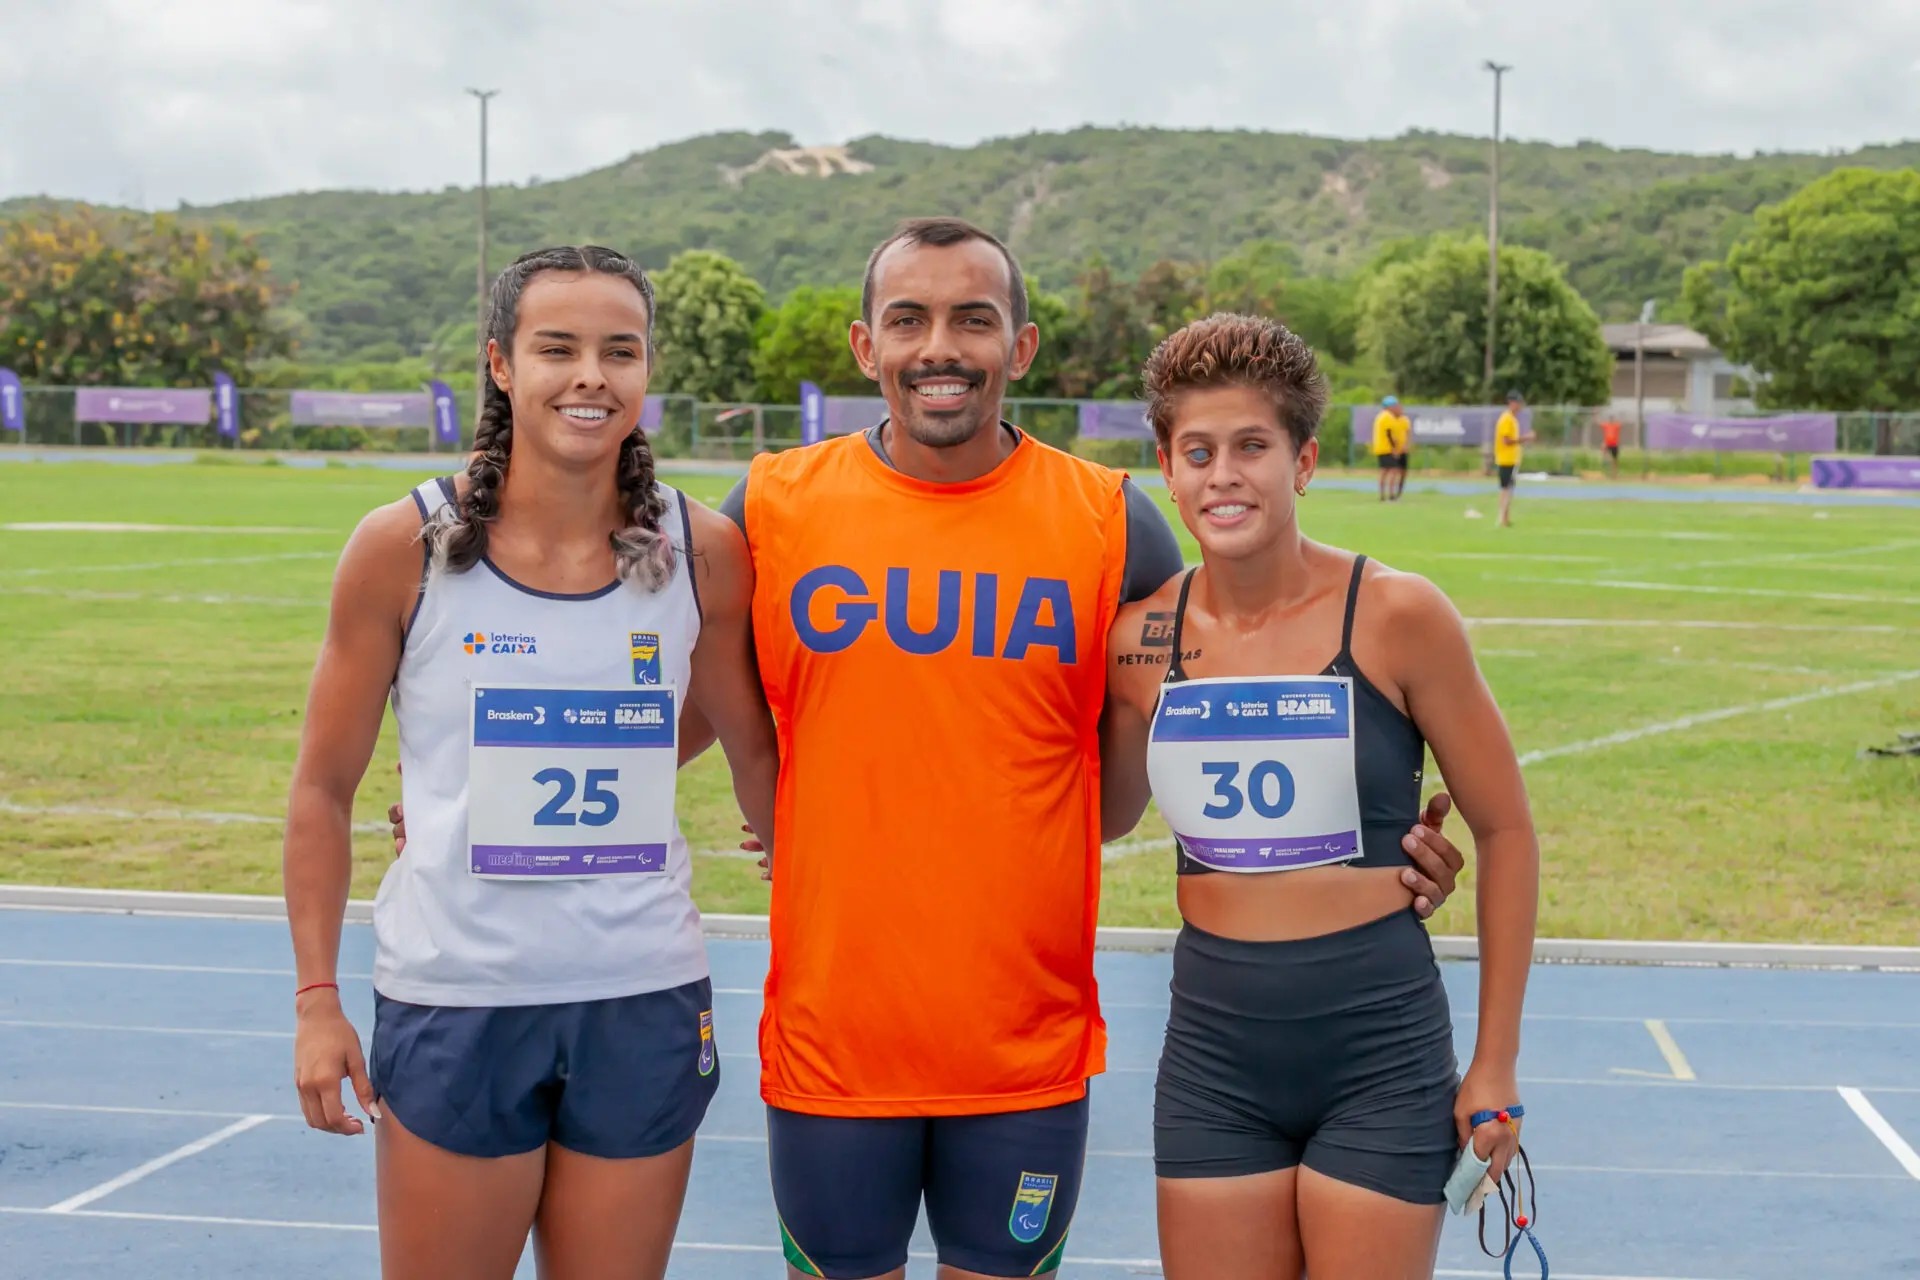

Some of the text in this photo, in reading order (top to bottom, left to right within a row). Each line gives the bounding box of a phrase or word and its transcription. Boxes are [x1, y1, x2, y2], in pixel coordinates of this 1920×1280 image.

[789, 564, 1077, 665] GUIA
[491, 632, 537, 643] loterias
[491, 643, 537, 654] CAIXA
[1241, 701, 1268, 709] loterias
[1277, 699, 1336, 716] BRASIL
[487, 709, 534, 721] Braskem
[580, 709, 607, 717] loterias
[614, 709, 665, 724] BRASIL
[1165, 705, 1201, 717] Braskem
[1241, 708, 1269, 716] CAIXA
[580, 716, 607, 724] CAIXA
[1201, 759, 1296, 820] 30
[532, 767, 620, 827] 25
[1025, 1176, 1052, 1185] BRASIL
